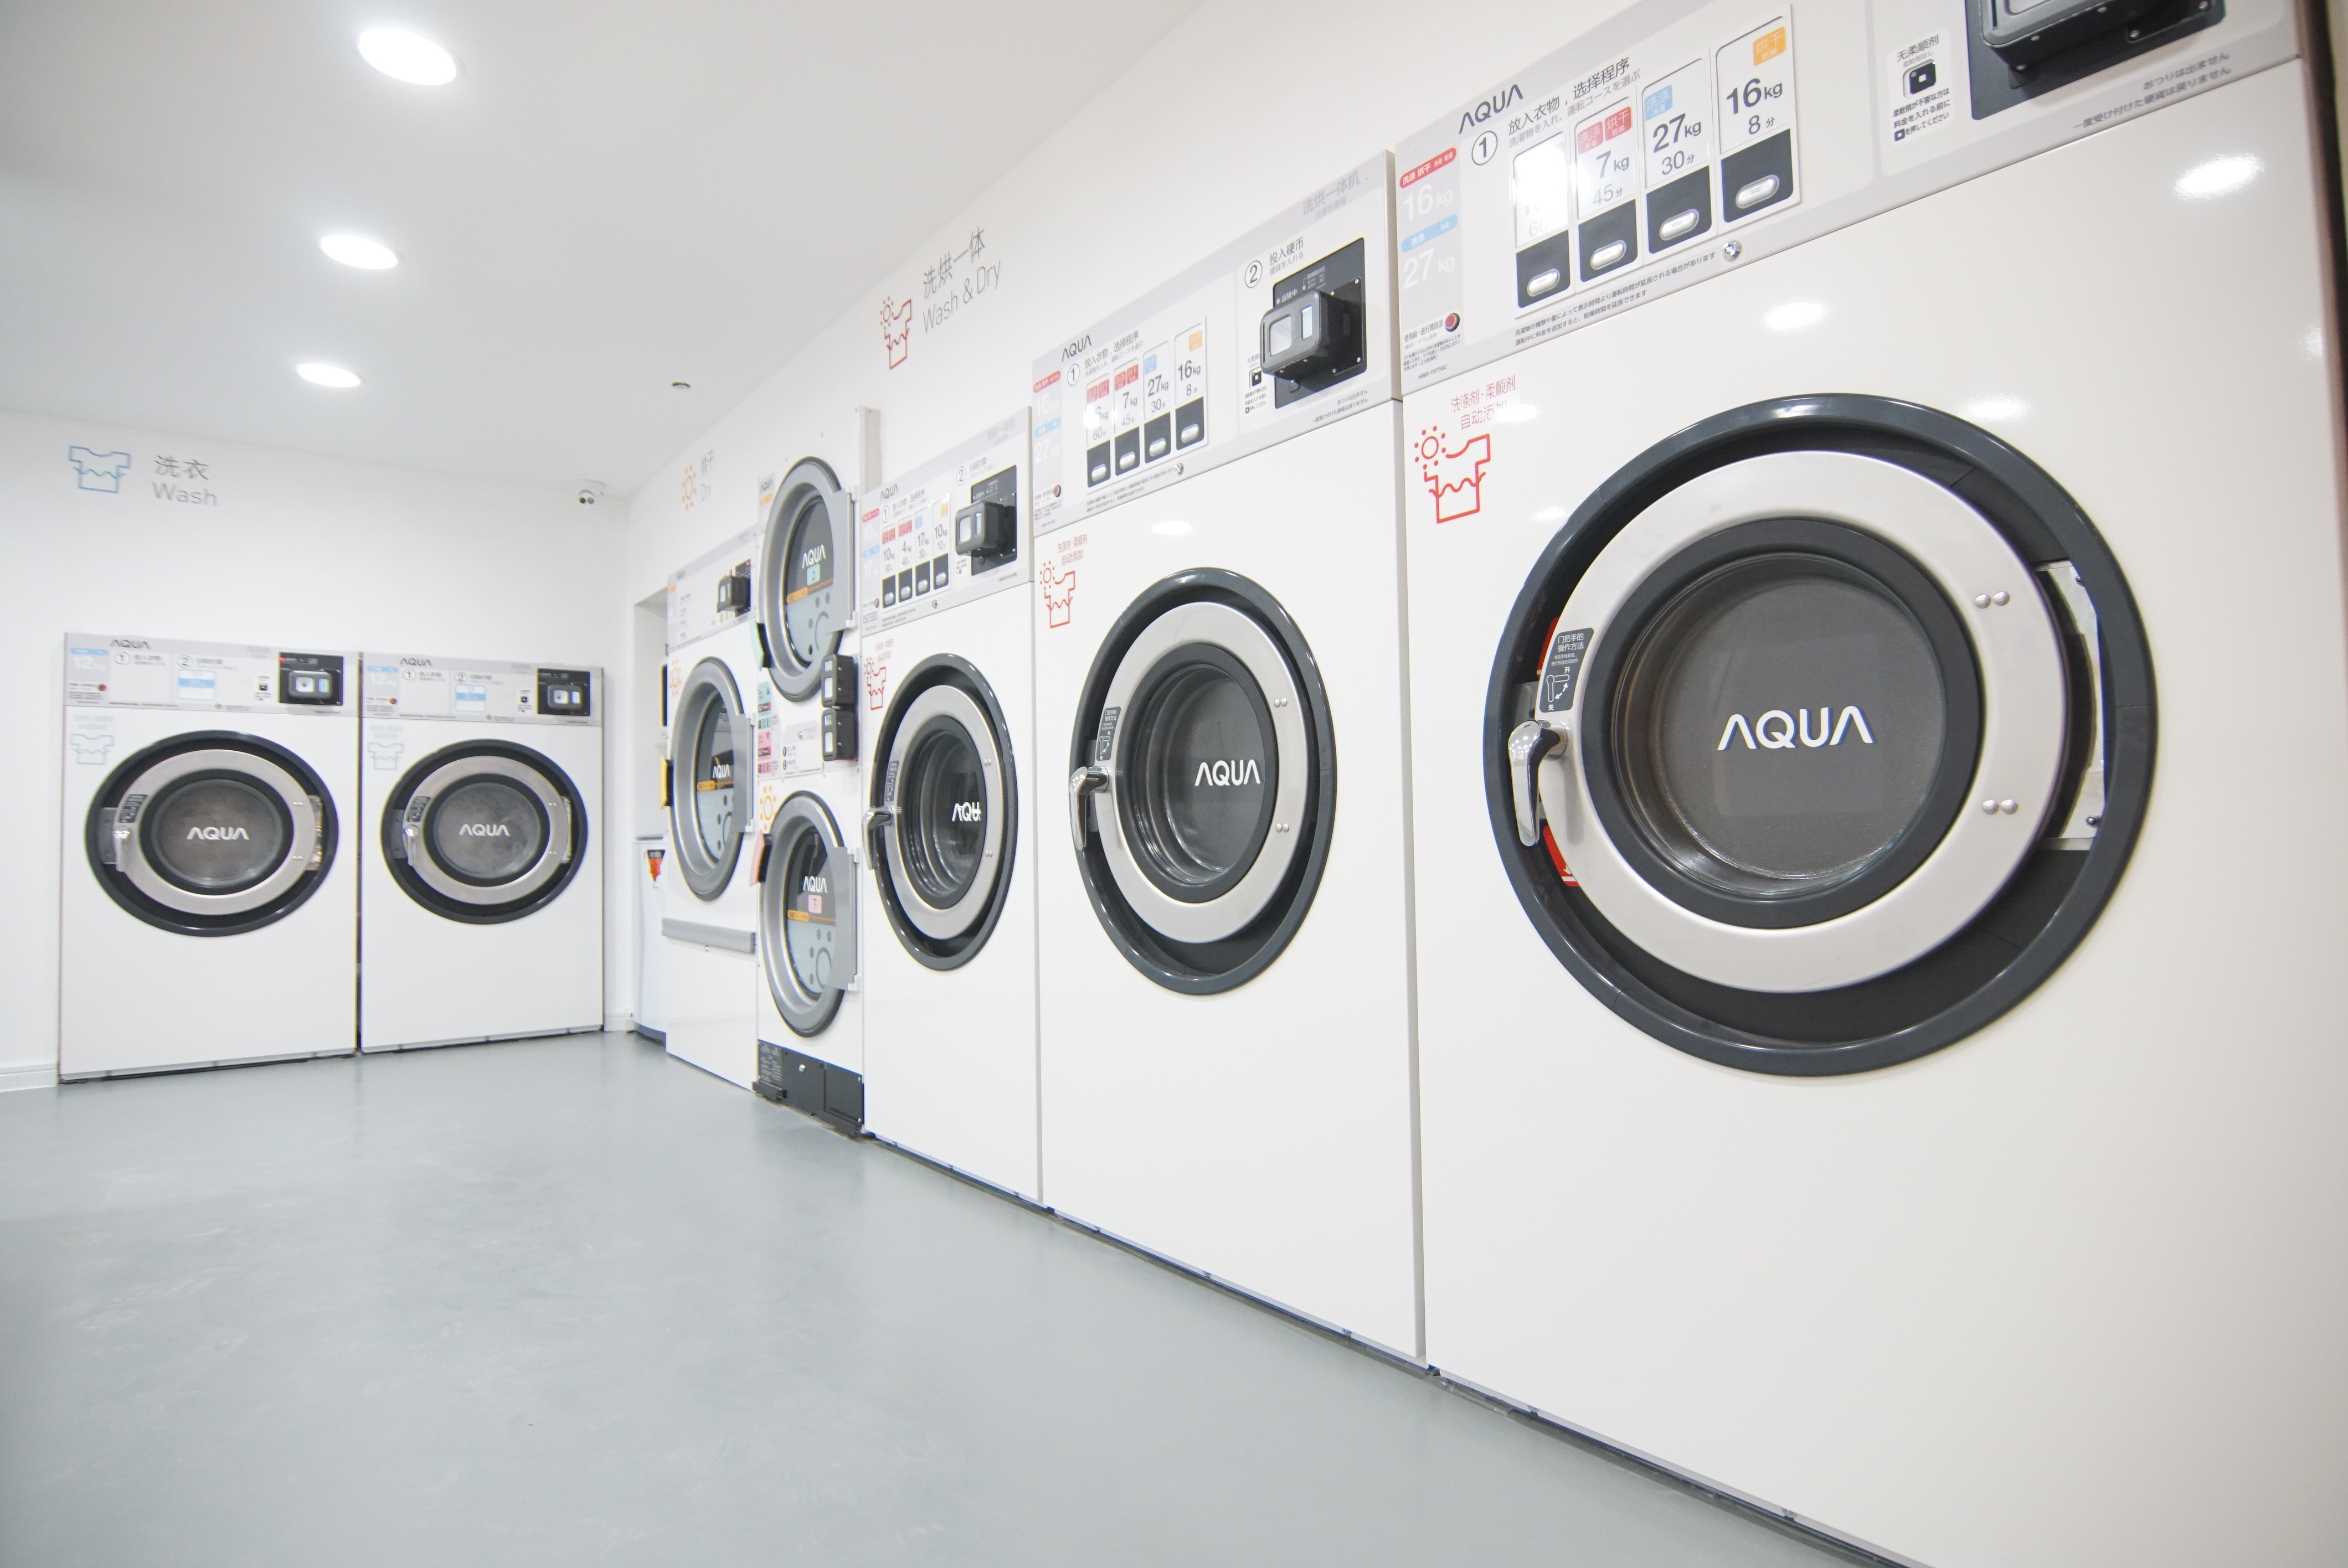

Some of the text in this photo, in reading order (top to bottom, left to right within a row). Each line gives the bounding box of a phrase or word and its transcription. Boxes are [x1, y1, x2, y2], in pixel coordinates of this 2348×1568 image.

[1755, 30, 1783, 54] 烘干
[1897, 34, 1939, 63] 无柔顺剂
[1727, 78, 1783, 115] 16kg
[1459, 84, 1523, 134] AQUA
[1606, 109, 1630, 131] 烘干
[1893, 99, 1951, 128] 料金を入れる前に
[1653, 113, 1701, 153] 27kg
[923, 226, 985, 300] 洗烘一体
[1269, 236, 1304, 266] 投入硬币
[923, 260, 1001, 333] Wash & Dry
[1062, 334, 1091, 362] AQUA
[1178, 360, 1201, 381] 16kg
[1148, 374, 1168, 397] 27kg
[155, 455, 209, 480] 洗衣
[701, 450, 714, 476] 烘干
[152, 481, 218, 506] Wash
[760, 478, 773, 493] AQUA
[880, 483, 898, 502] AQUA
[802, 544, 826, 569] AQUA
[110, 639, 150, 649] AQUA
[1558, 633, 1584, 644] 门把手的
[1558, 642, 1584, 653] 操作方法
[400, 658, 432, 667] AQUA
[1717, 705, 1875, 750] AQUA
[712, 764, 730, 778] AQUA
[1194, 759, 1260, 786] AQUA
[952, 802, 981, 822] AQU
[186, 826, 250, 840] AQUA
[459, 823, 510, 837] AQUA
[803, 876, 828, 894] AQUA
